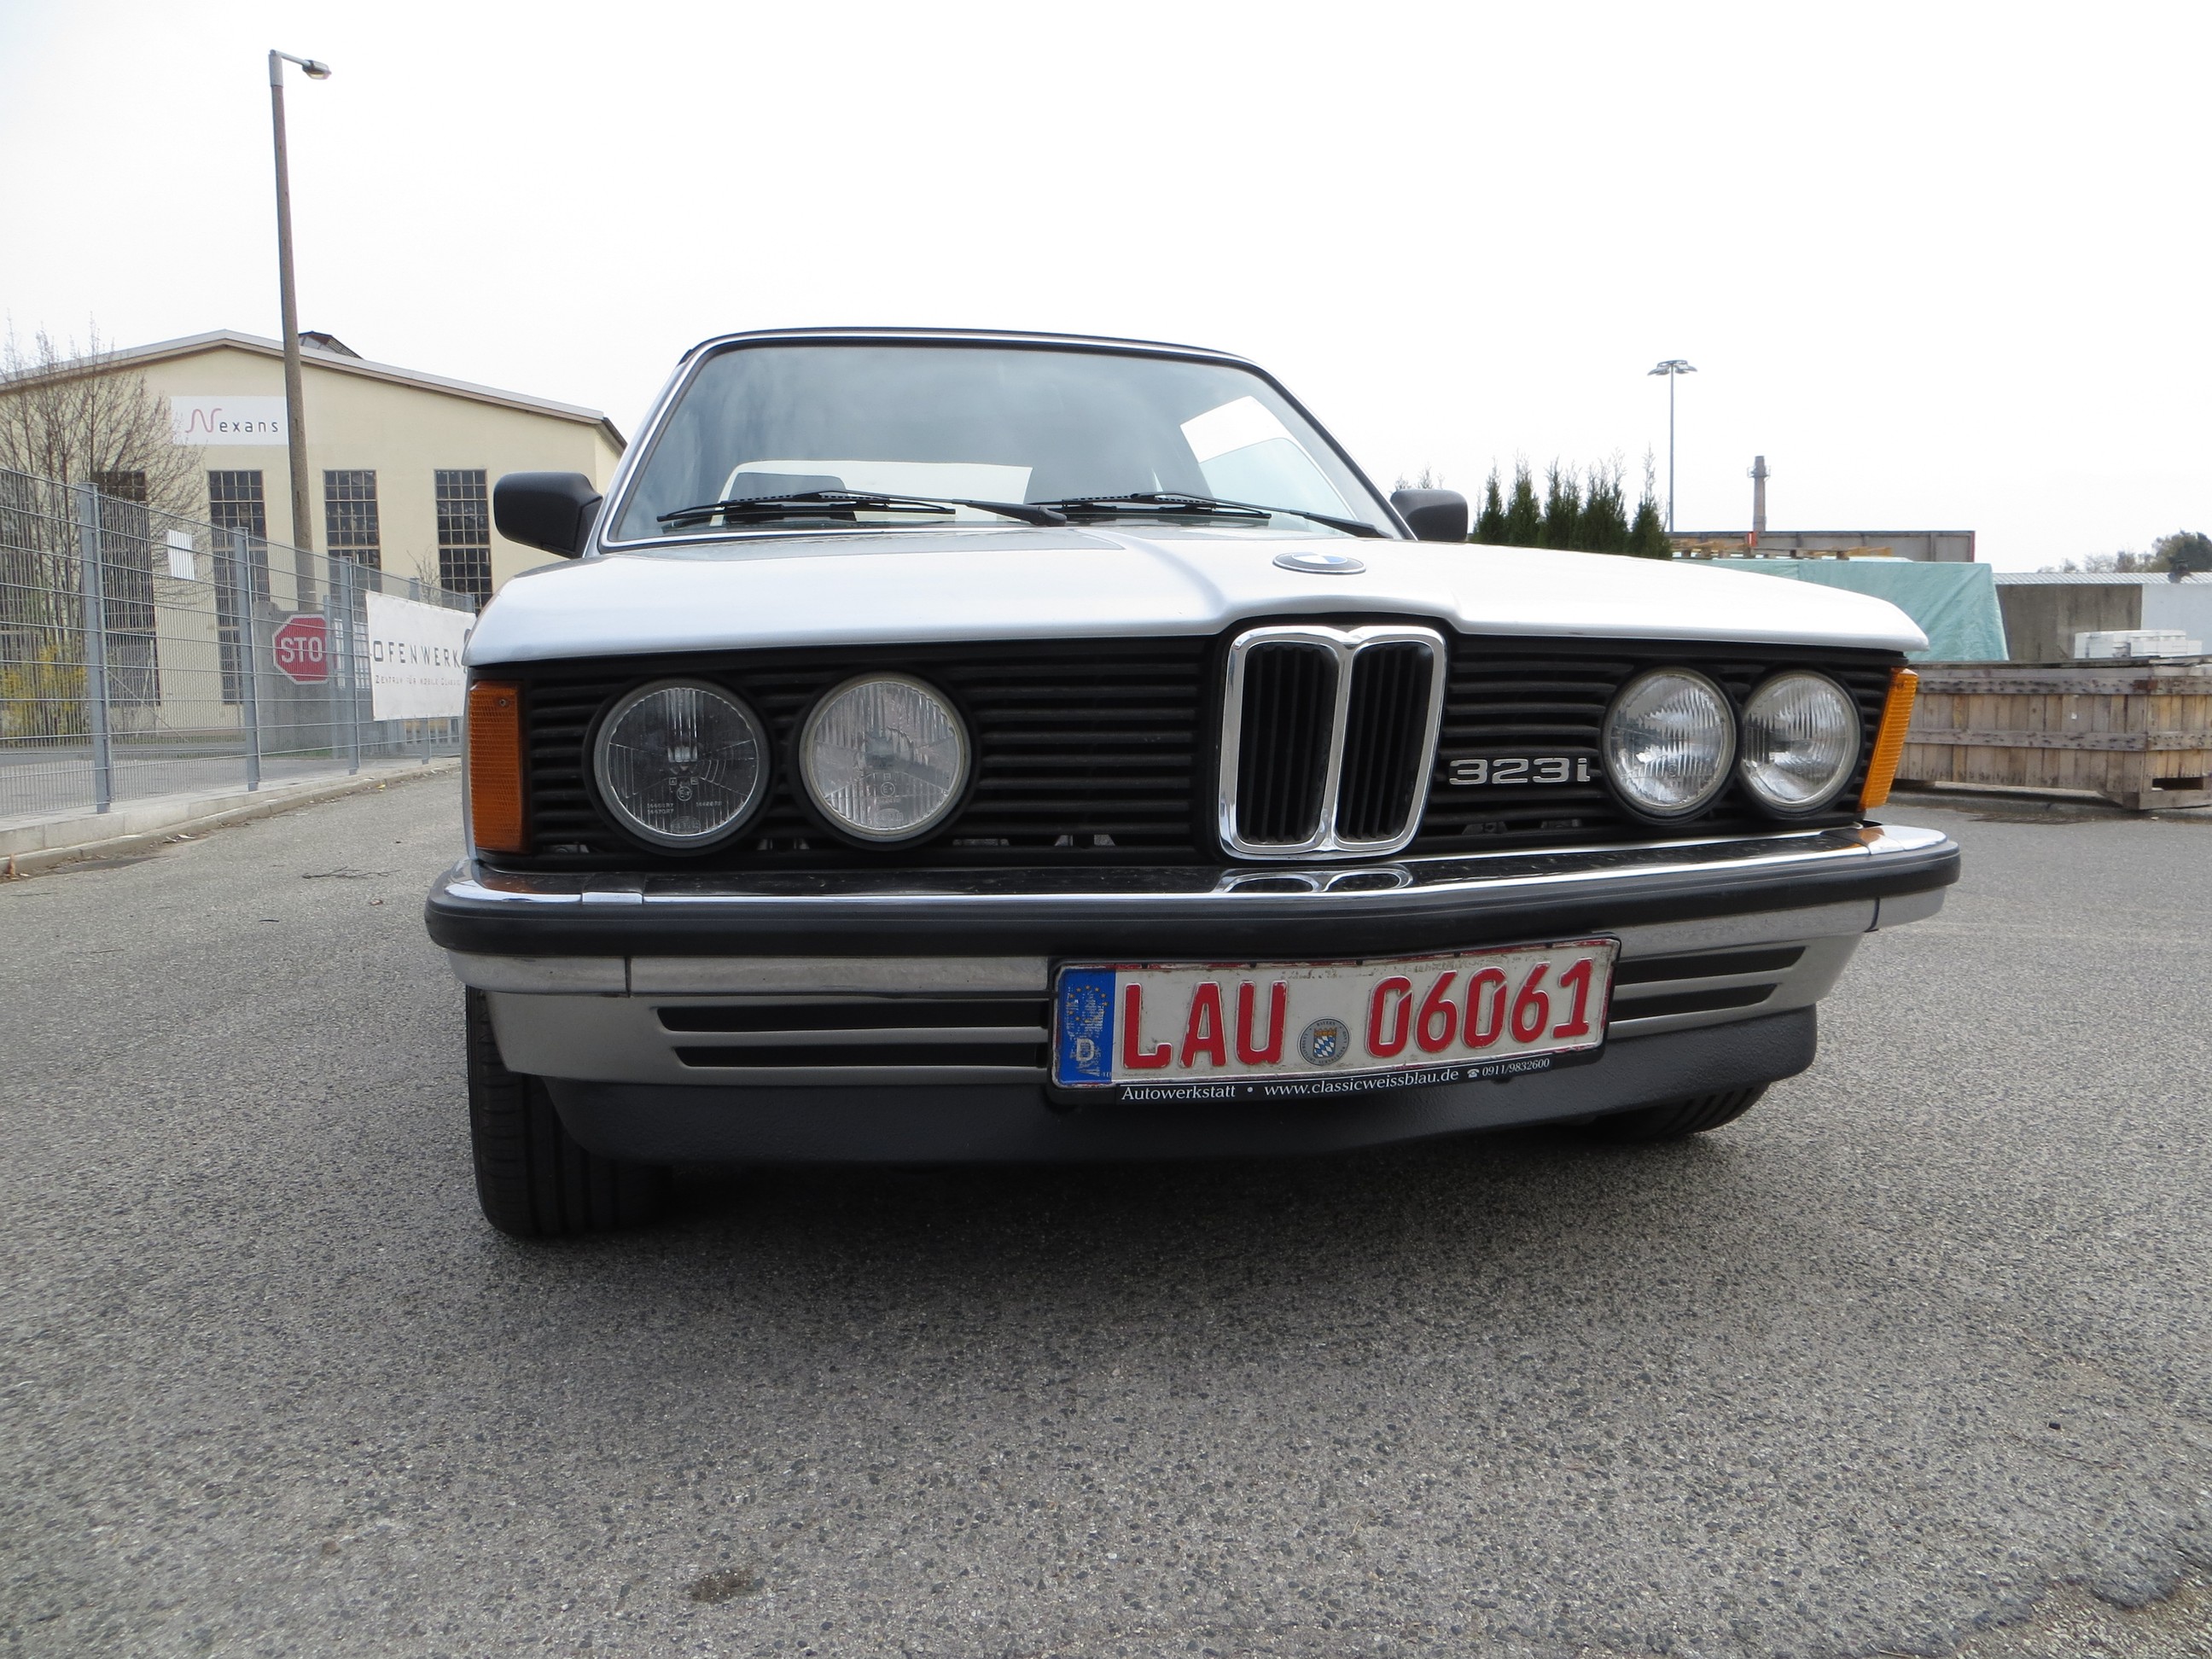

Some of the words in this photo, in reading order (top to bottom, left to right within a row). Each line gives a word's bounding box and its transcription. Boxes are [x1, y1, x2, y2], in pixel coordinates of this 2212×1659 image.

[184, 408, 278, 433] Nexans
[280, 637, 323, 663] STO
[373, 640, 461, 668] OFENWERK
[1449, 757, 1591, 785] 323i
[1121, 981, 1288, 1070] LAU
[1365, 957, 1594, 1059] 06061
[1076, 1038, 1096, 1062] D
[1121, 1085, 1237, 1101] Autowerkstatt
[1264, 1069, 1459, 1096] www.classicweissblau.de
[1481, 1058, 1551, 1077] 0911/9832600
